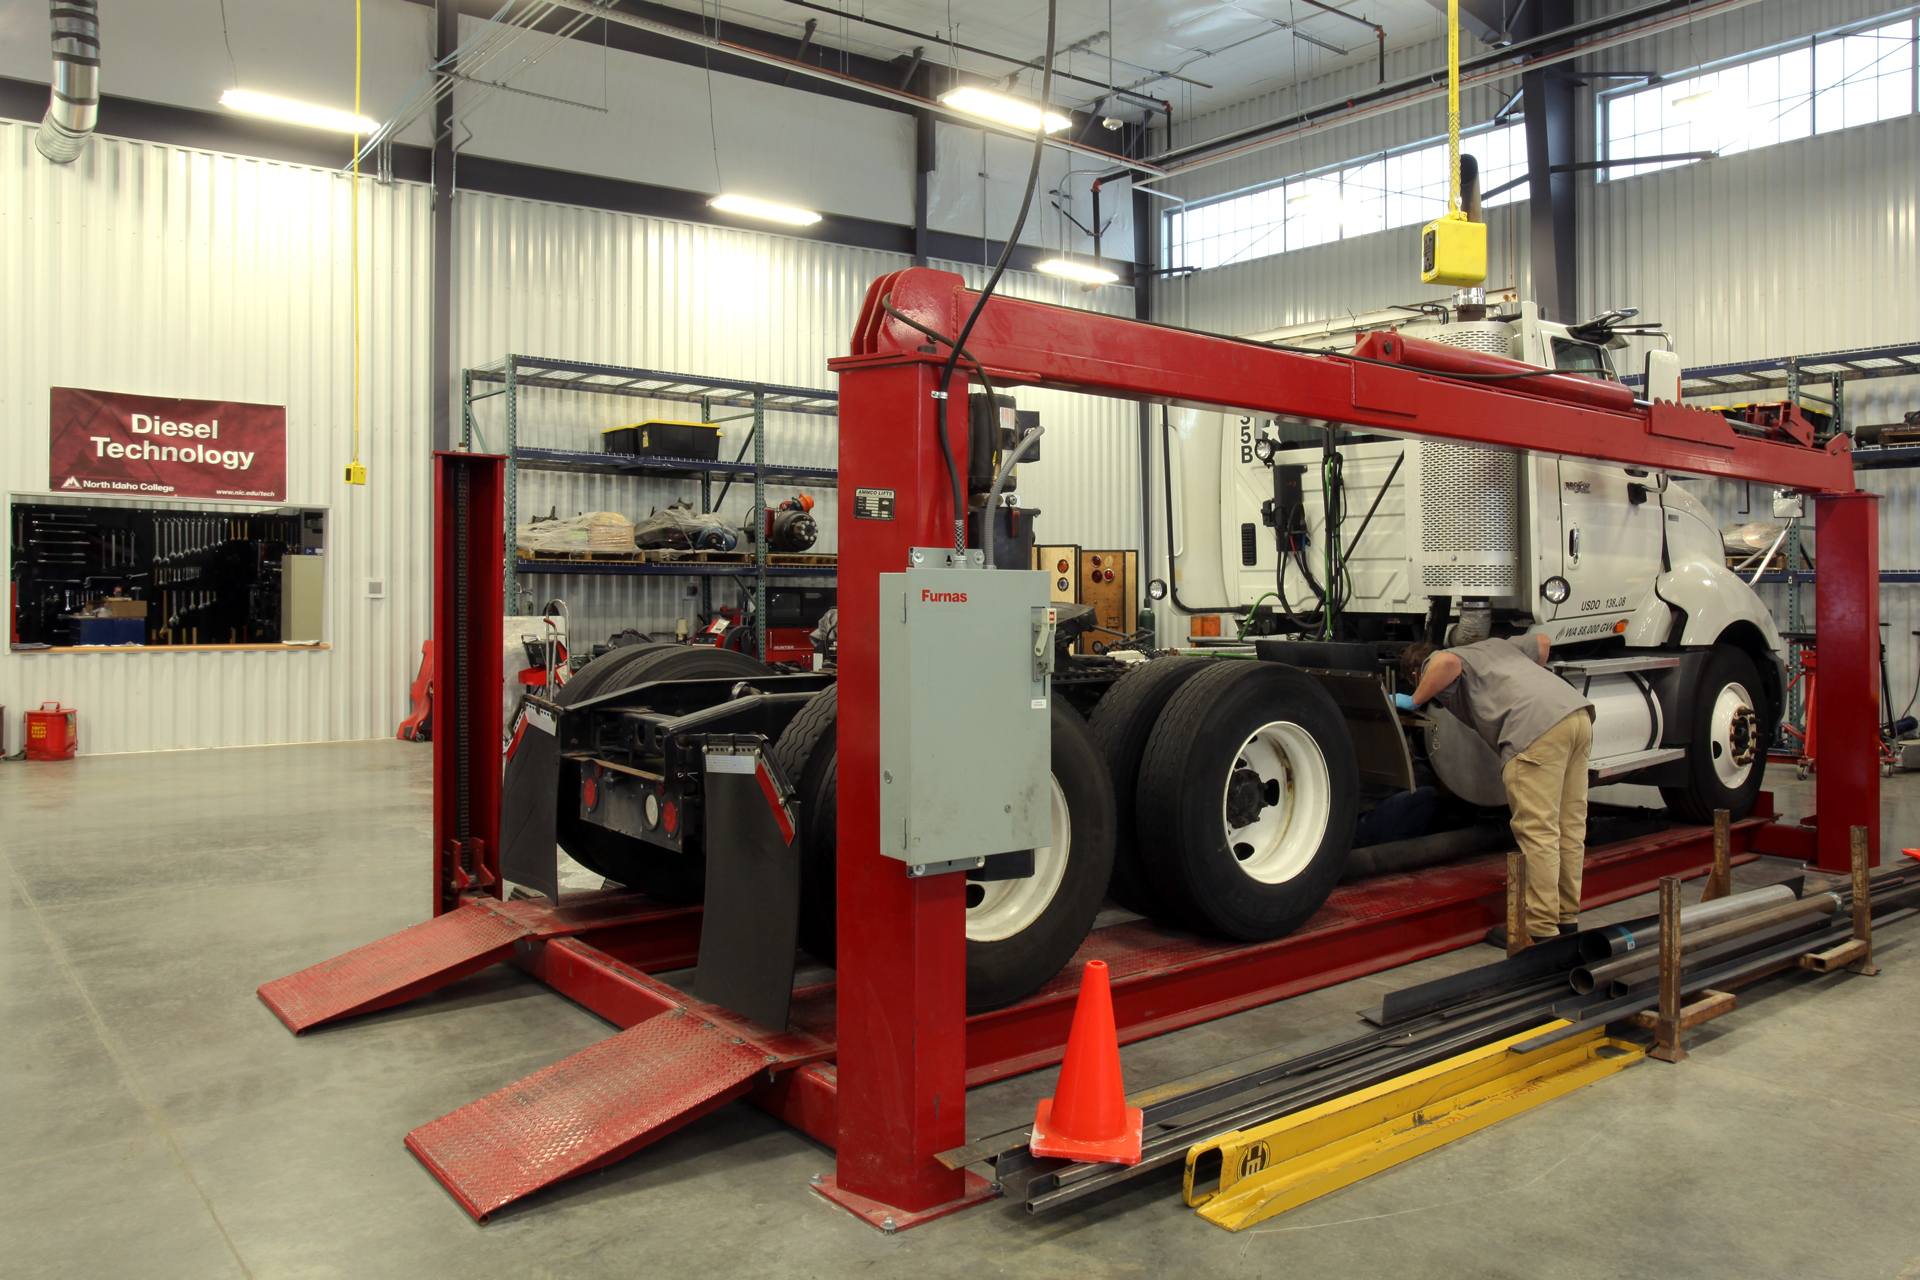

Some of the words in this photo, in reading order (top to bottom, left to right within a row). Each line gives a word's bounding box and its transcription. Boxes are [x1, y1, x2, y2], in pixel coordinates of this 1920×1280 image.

[131, 413, 219, 439] Diesel
[90, 436, 255, 470] Technology
[83, 480, 111, 490] North
[112, 481, 139, 491] Idaho
[140, 482, 175, 493] College
[216, 489, 275, 497] www.nic.edu/tech
[922, 589, 968, 603] Furnas
[1565, 627, 1578, 637] WA
